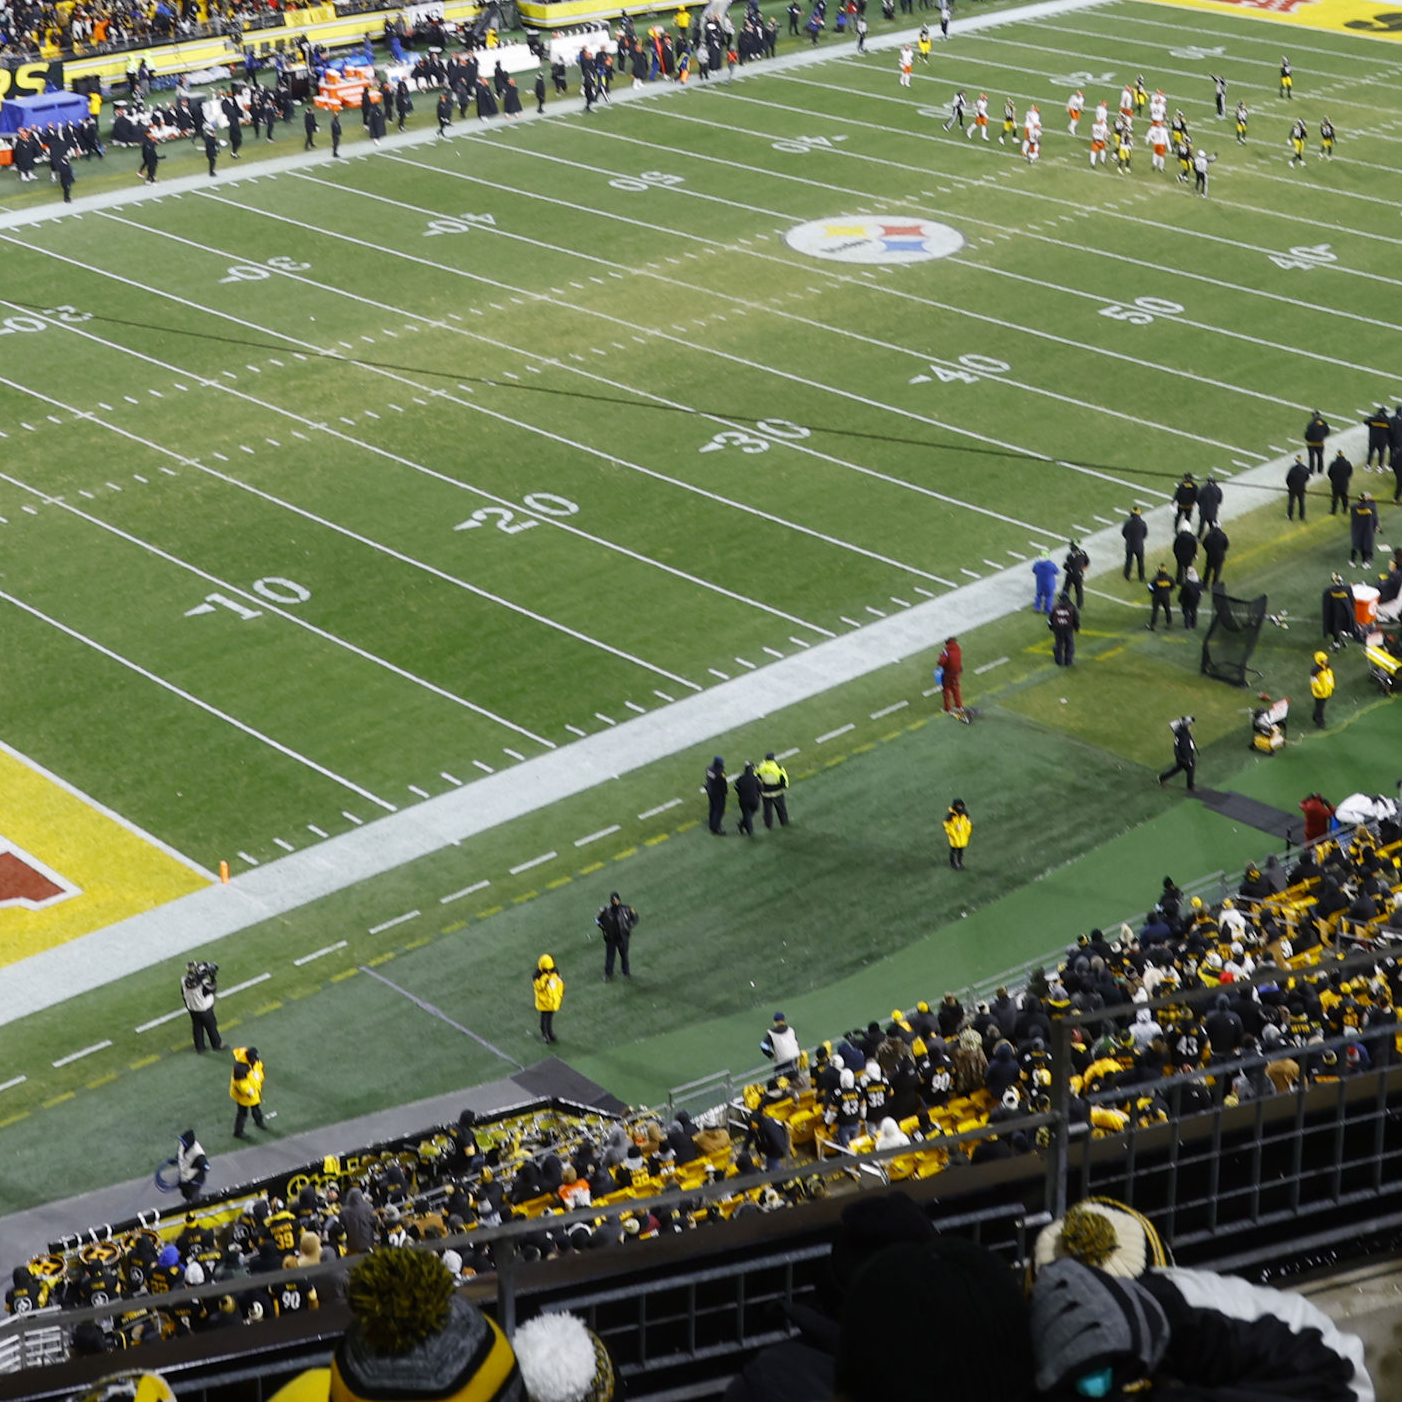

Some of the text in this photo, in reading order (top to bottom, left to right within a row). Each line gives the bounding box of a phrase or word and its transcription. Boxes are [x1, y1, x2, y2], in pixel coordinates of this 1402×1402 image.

[607, 169, 685, 193] 50
[427, 211, 497, 236] 40
[226, 255, 312, 282] 30
[1267, 243, 1339, 271] 40
[2, 304, 94, 333] 20
[1098, 296, 1185, 326] 50
[929, 352, 1012, 385] 40
[712, 417, 812, 454] 30
[470, 491, 580, 535] 20
[205, 576, 312, 620] 10
[282, 1289, 301, 1310] 90
